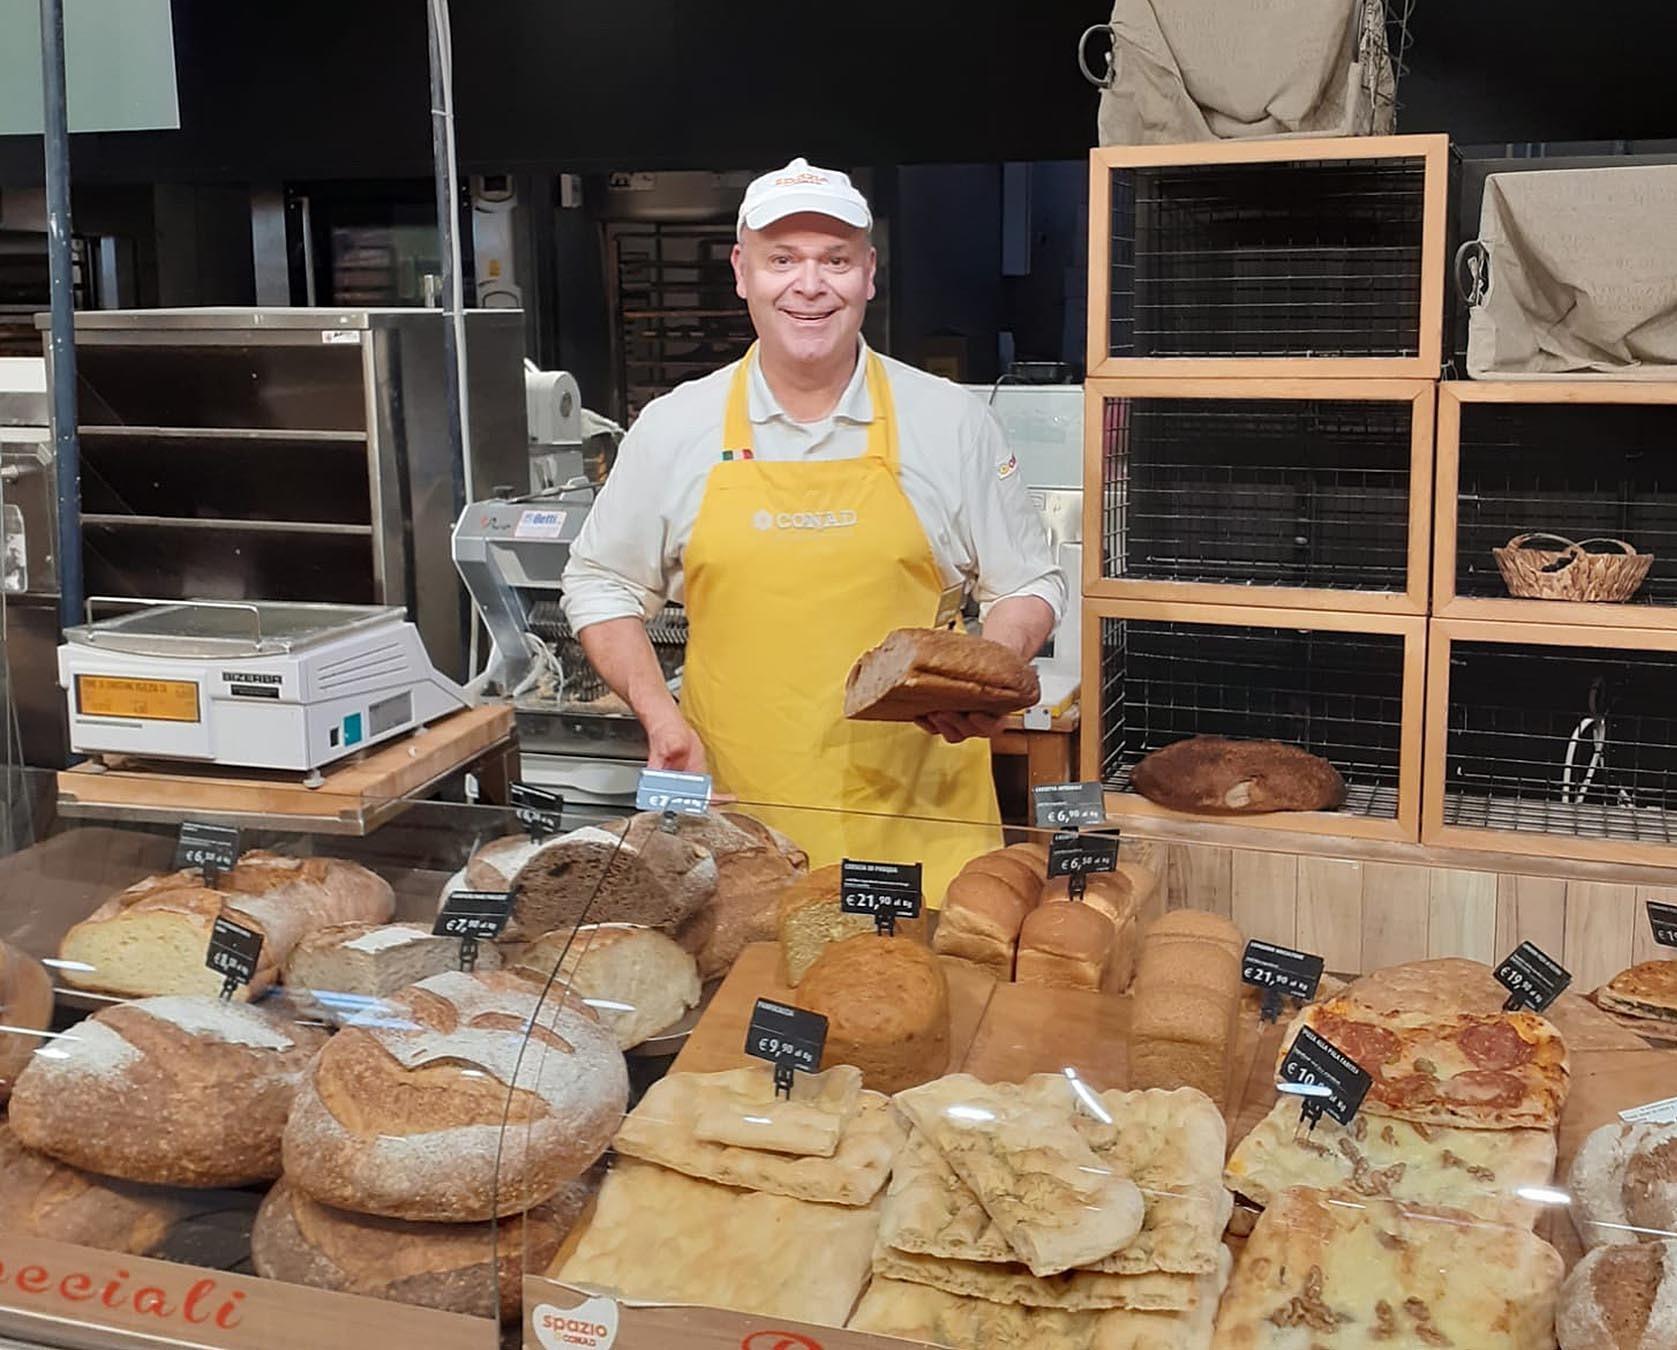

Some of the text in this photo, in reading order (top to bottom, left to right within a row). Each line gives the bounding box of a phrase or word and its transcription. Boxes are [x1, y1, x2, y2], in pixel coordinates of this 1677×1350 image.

[775, 509, 858, 529] CONAD
[222, 671, 283, 685] BIZERBA
[0, 1260, 247, 1330] eciali
[543, 1314, 608, 1338] spazio
